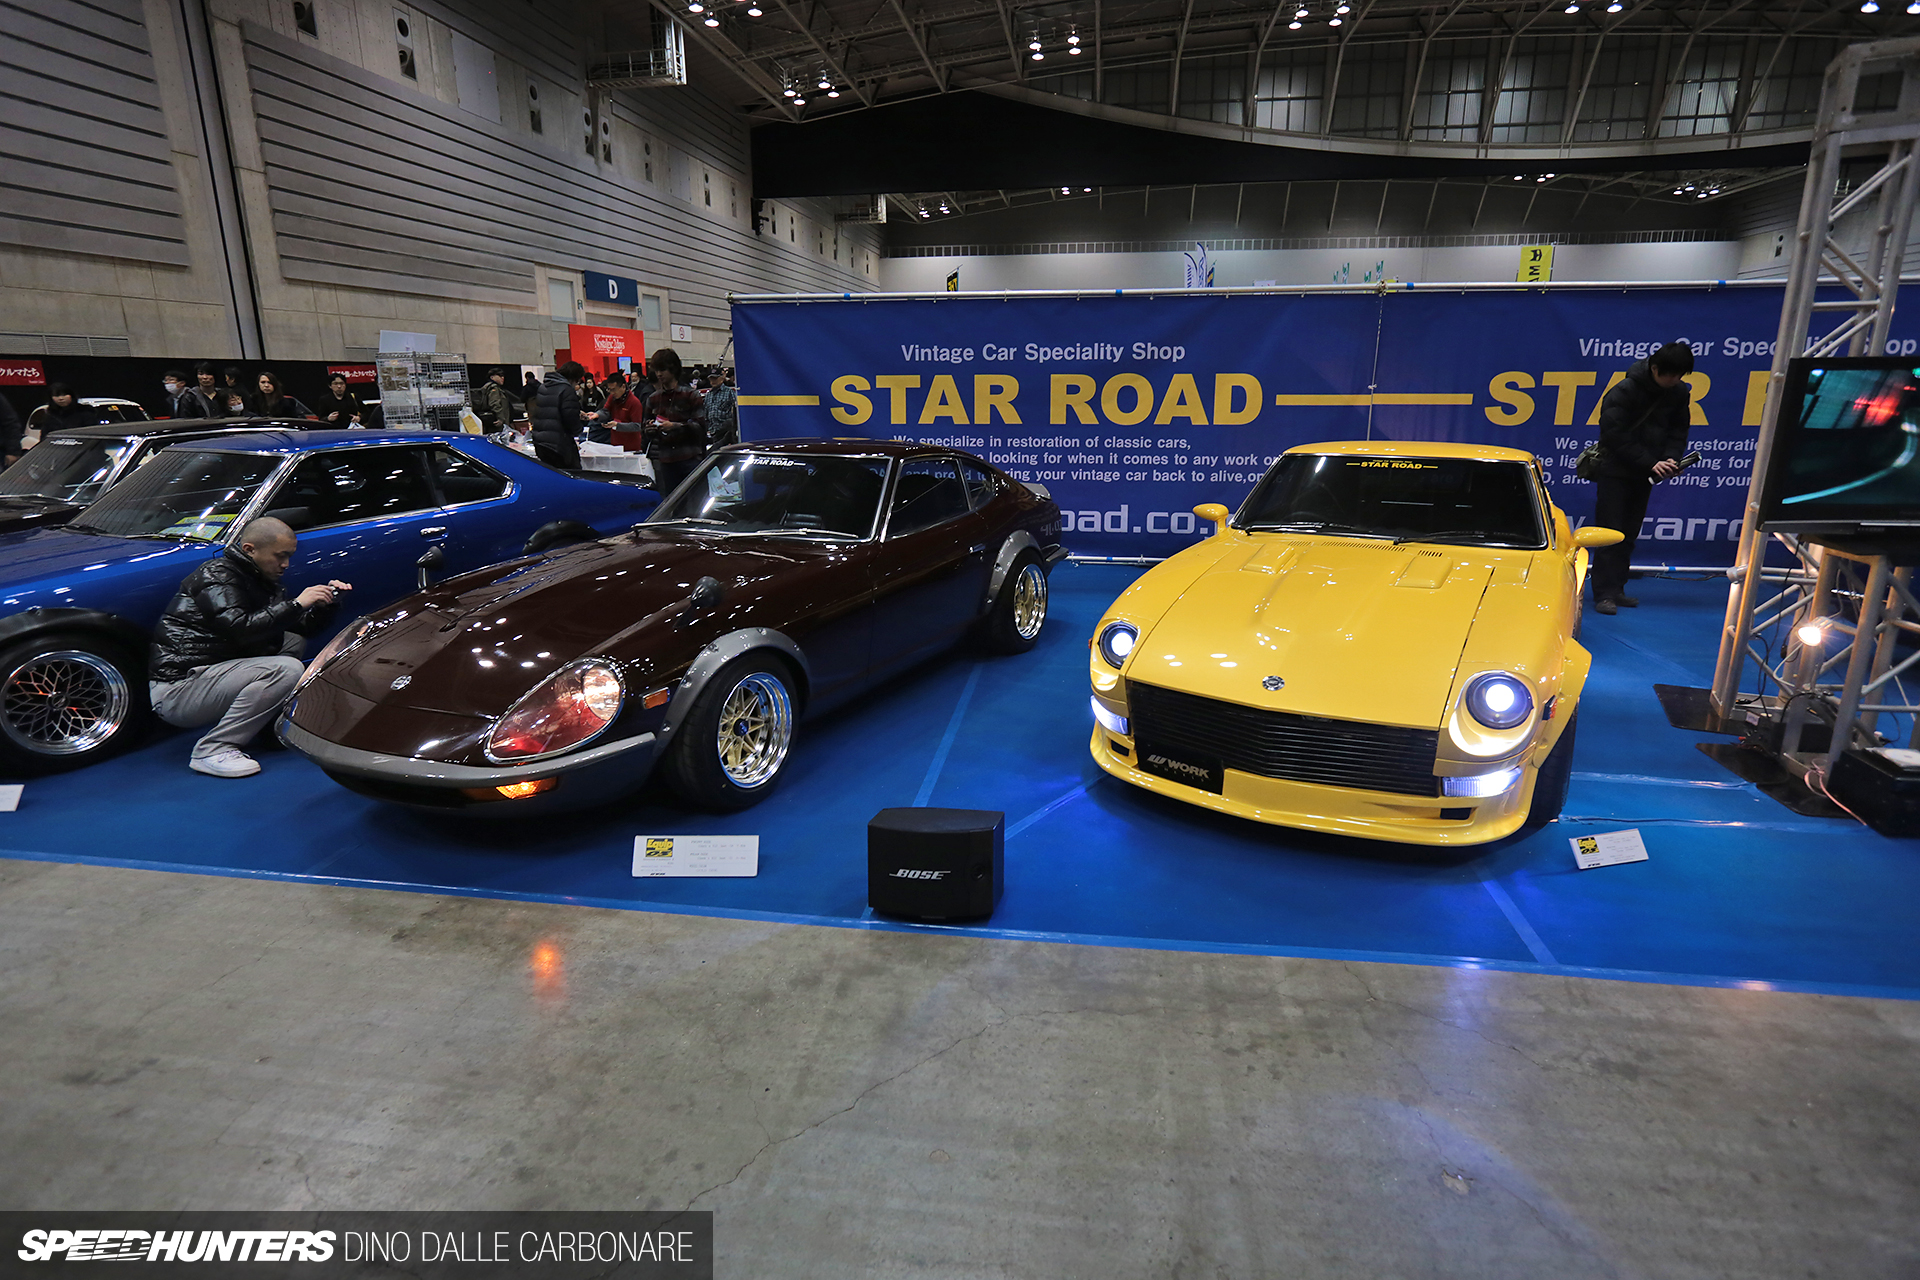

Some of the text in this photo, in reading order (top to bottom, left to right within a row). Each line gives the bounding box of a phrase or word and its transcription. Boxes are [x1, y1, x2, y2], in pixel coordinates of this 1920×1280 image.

[608, 279, 619, 299] D
[901, 342, 1186, 364] Vintage Car Speciality Shop
[1579, 338, 1663, 360] Vintage
[830, 372, 1263, 426] STAR ROAD
[919, 435, 985, 447] specialize
[990, 435, 1001, 447] in
[1007, 436, 1082, 447] restoration
[1085, 436, 1099, 448] of
[1104, 436, 1152, 448] classic
[1157, 438, 1191, 450] cars,
[1555, 437, 1578, 450] We
[989, 452, 1038, 465] looking
[1043, 452, 1061, 464] for
[1068, 453, 1103, 464] when
[1109, 453, 1118, 465] it
[1123, 455, 1168, 465] comes
[1174, 454, 1187, 465] to
[1193, 455, 1218, 467] any
[1224, 454, 1258, 466] work
[1536, 454, 1554, 467] he
[1559, 454, 1578, 469] lig
[1728, 456, 1751, 469] for
[1004, 468, 1031, 481] ring
[1036, 471, 1066, 482] your
[1071, 470, 1120, 482] vintage
[1126, 471, 1147, 481] car
[1153, 470, 1186, 482] back
[1191, 470, 1205, 482] to
[1669, 473, 1711, 487] bring
[1716, 475, 1752, 487] your
[1167, 759, 1210, 779] WORK
[889, 868, 951, 880] BOSE
